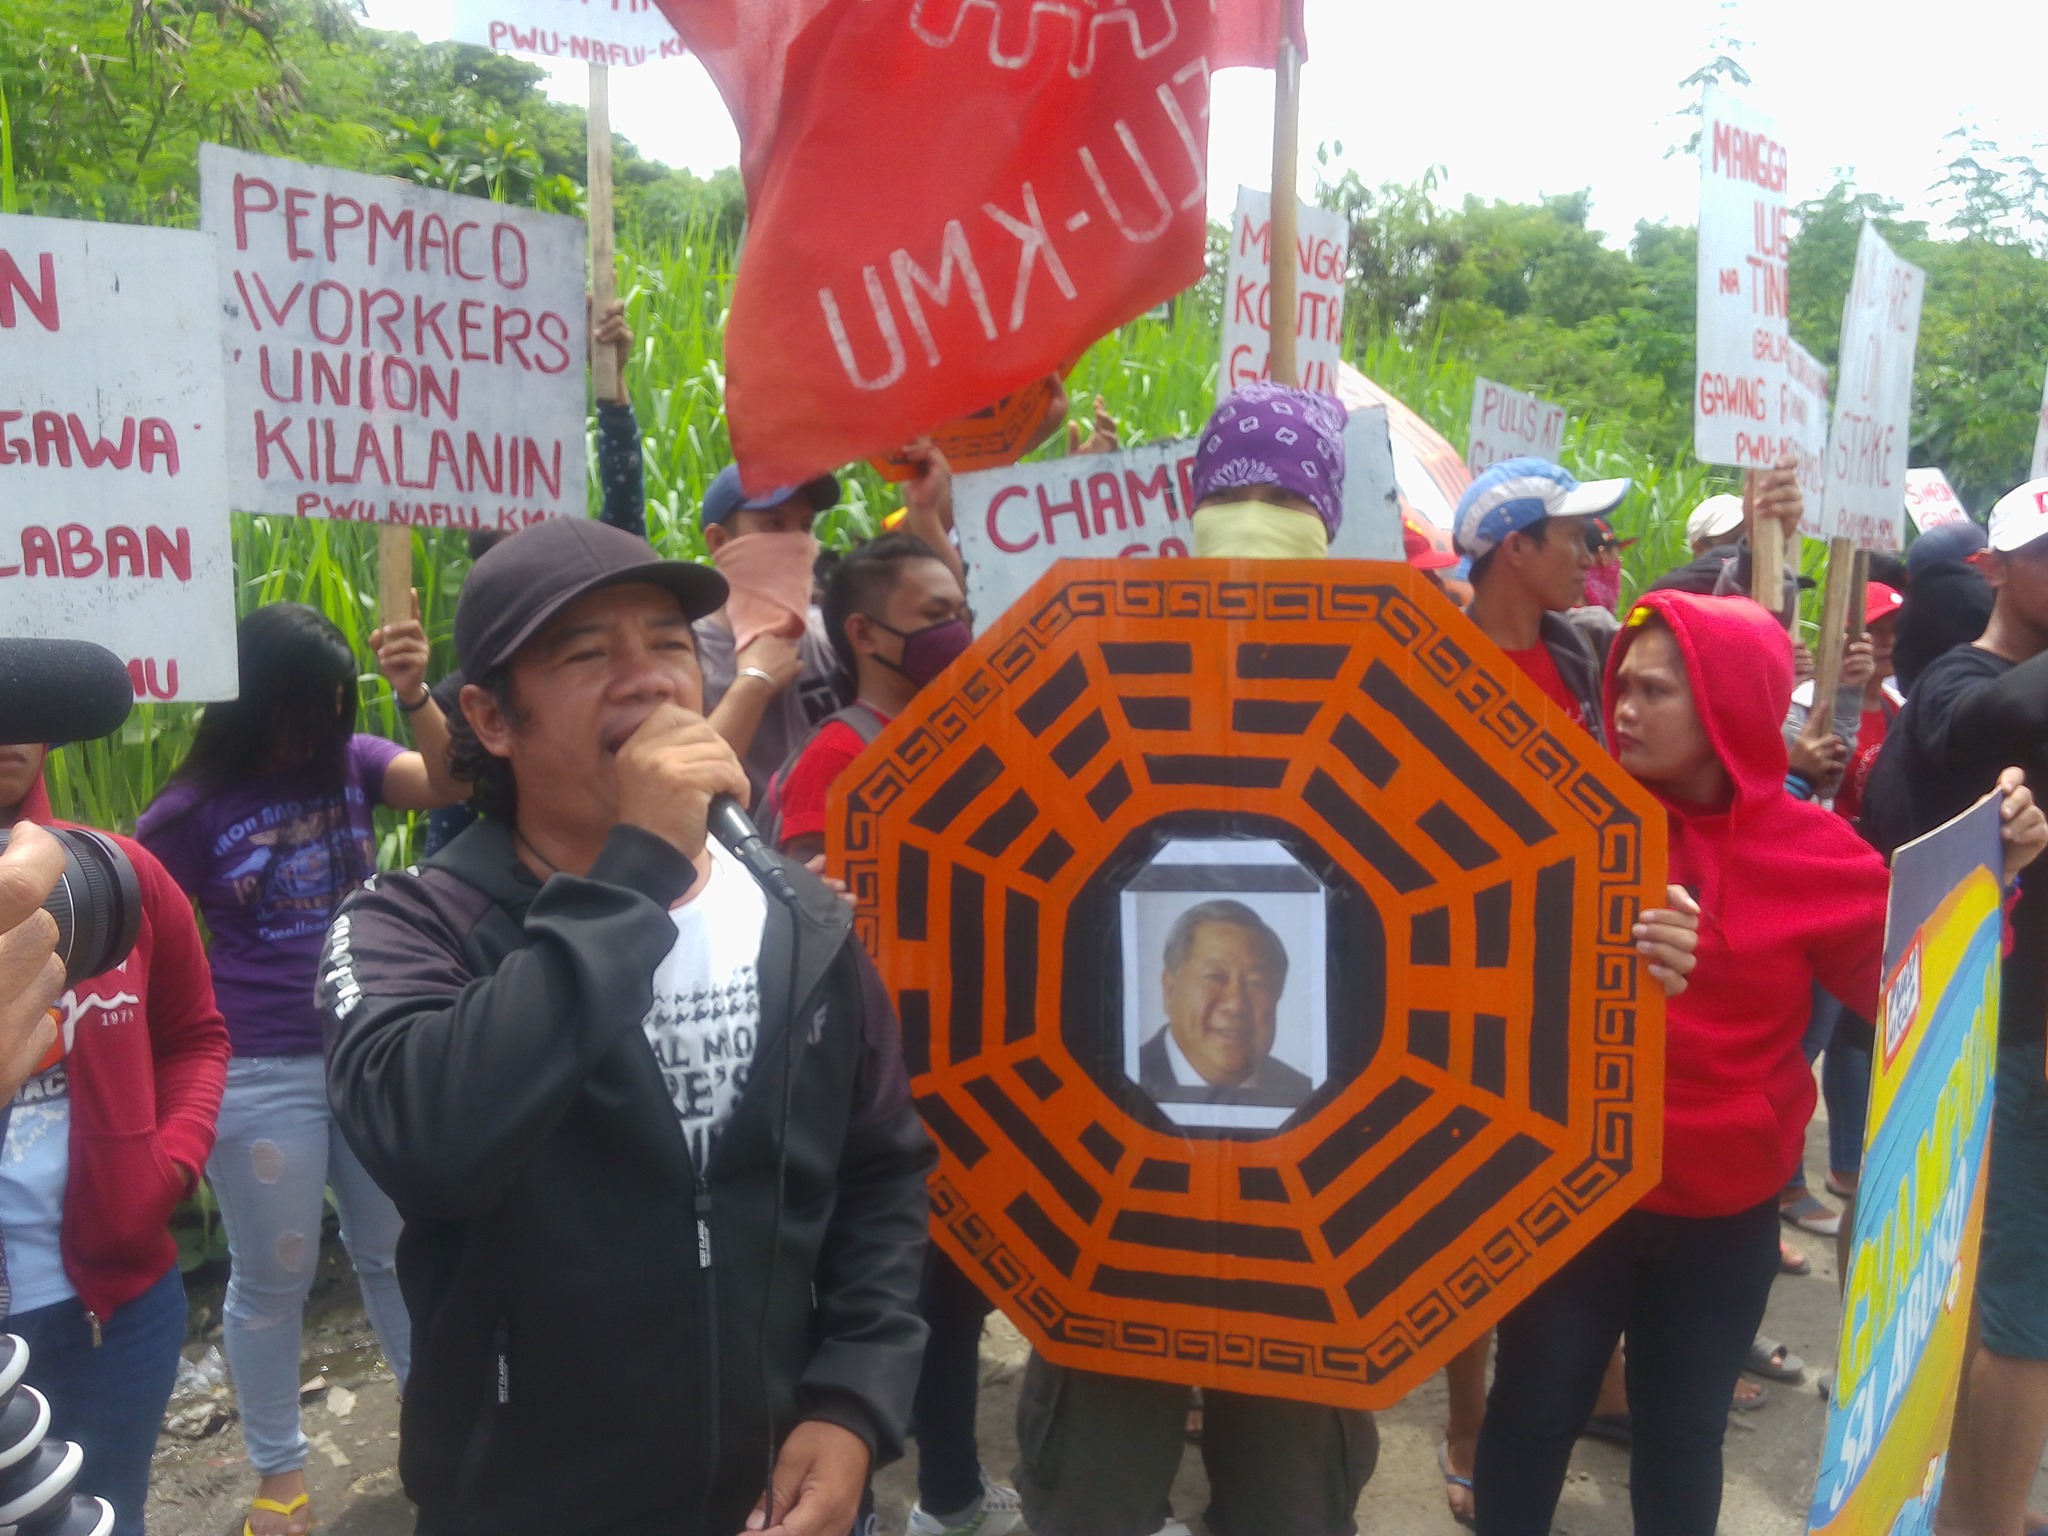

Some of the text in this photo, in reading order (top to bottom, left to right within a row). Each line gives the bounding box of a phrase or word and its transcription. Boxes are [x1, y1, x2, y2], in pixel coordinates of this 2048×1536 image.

[233, 173, 528, 290] PEPMACO
[233, 270, 570, 374] WORKERS
[259, 344, 459, 421] UNION
[254, 409, 562, 499] KILALANIN
